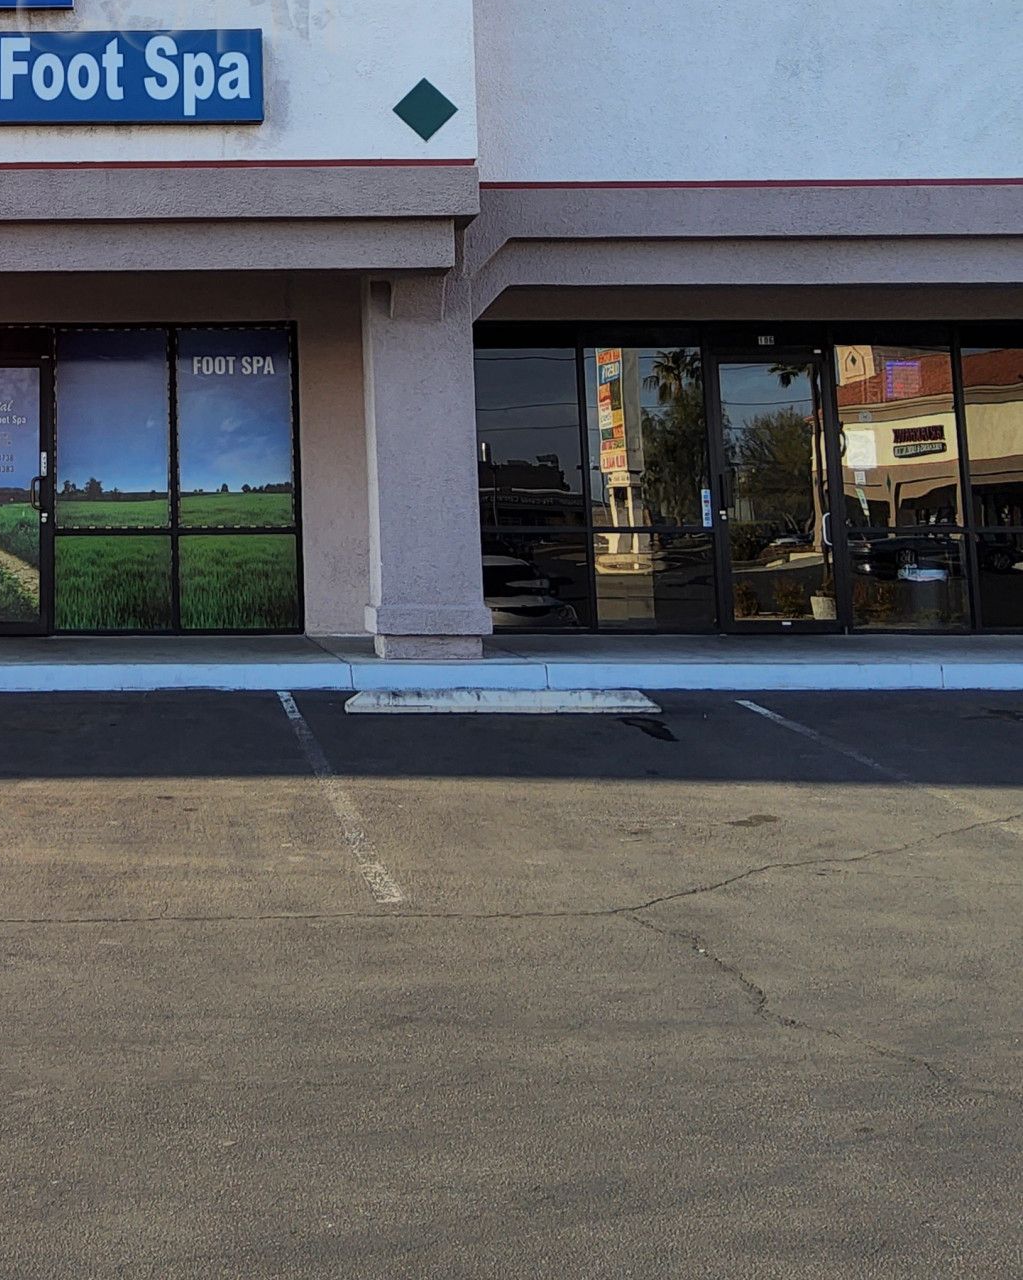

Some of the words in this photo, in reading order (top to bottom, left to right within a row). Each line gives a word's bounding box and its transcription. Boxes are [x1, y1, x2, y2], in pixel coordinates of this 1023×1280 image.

[0, 36, 125, 102] Foot
[144, 36, 252, 116] Spa
[193, 356, 236, 375] FOOT
[241, 356, 275, 375] SPA
[12, 414, 27, 426] Spa
